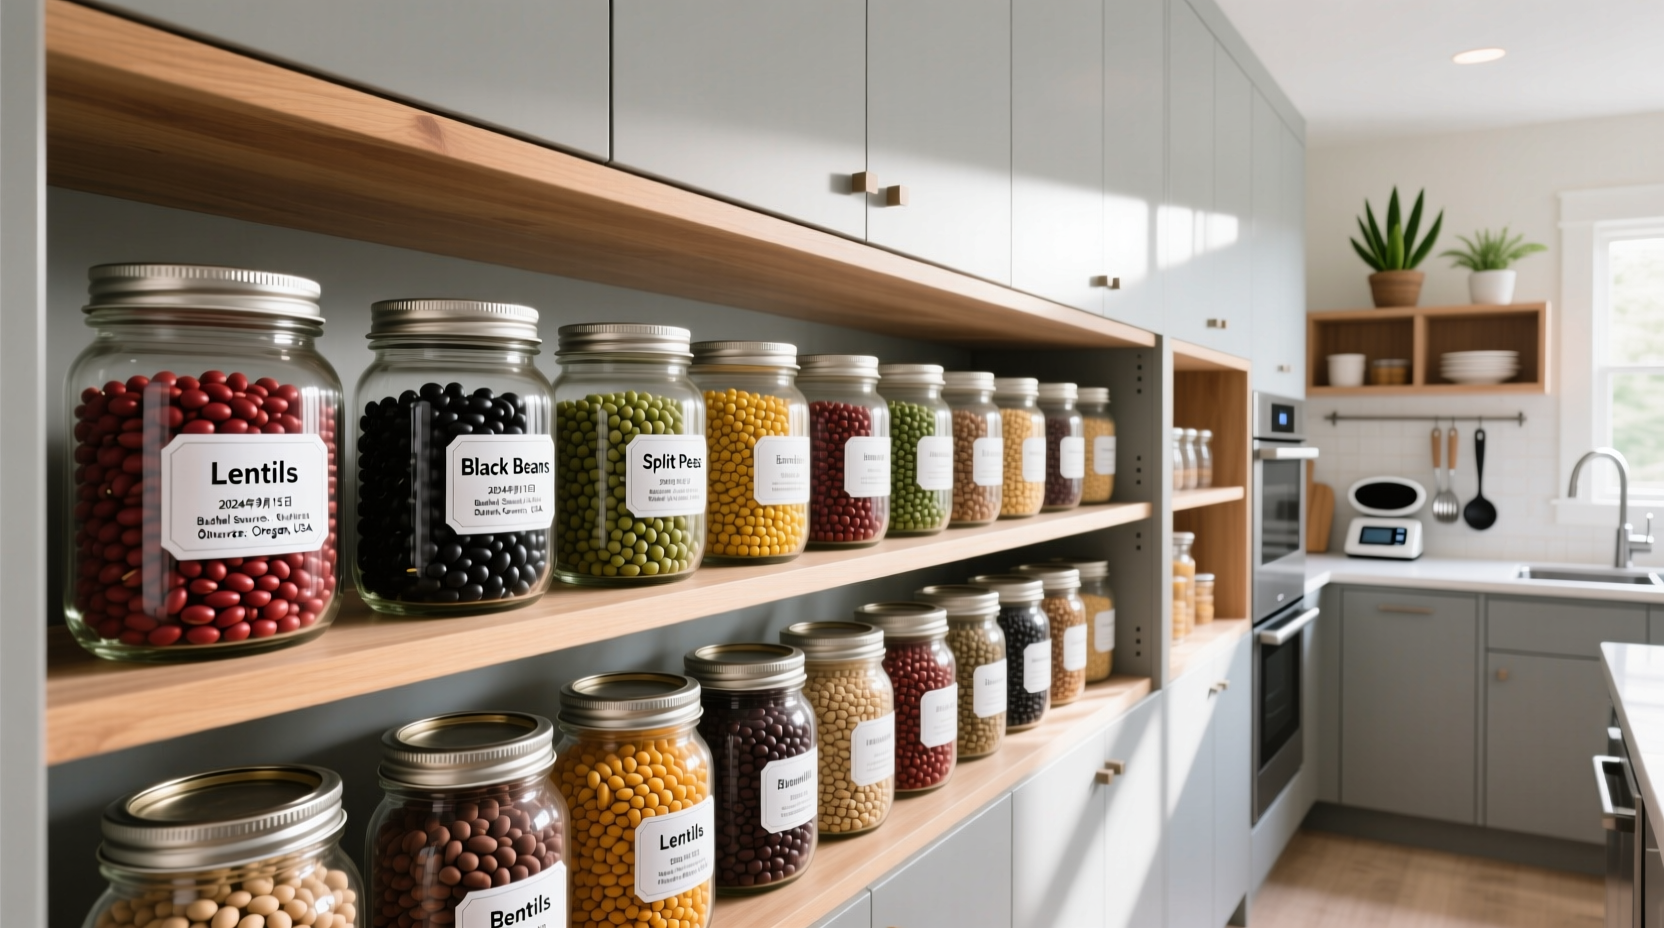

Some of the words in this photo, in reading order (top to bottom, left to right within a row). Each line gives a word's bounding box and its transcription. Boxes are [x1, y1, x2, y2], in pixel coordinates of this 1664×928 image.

[211, 460, 299, 485] Lentils
[461, 457, 509, 476] Black
[513, 457, 550, 475] Beans
[643, 453, 676, 474] Split
[660, 823, 704, 850] Lentils
[490, 894, 551, 928] Bentils
